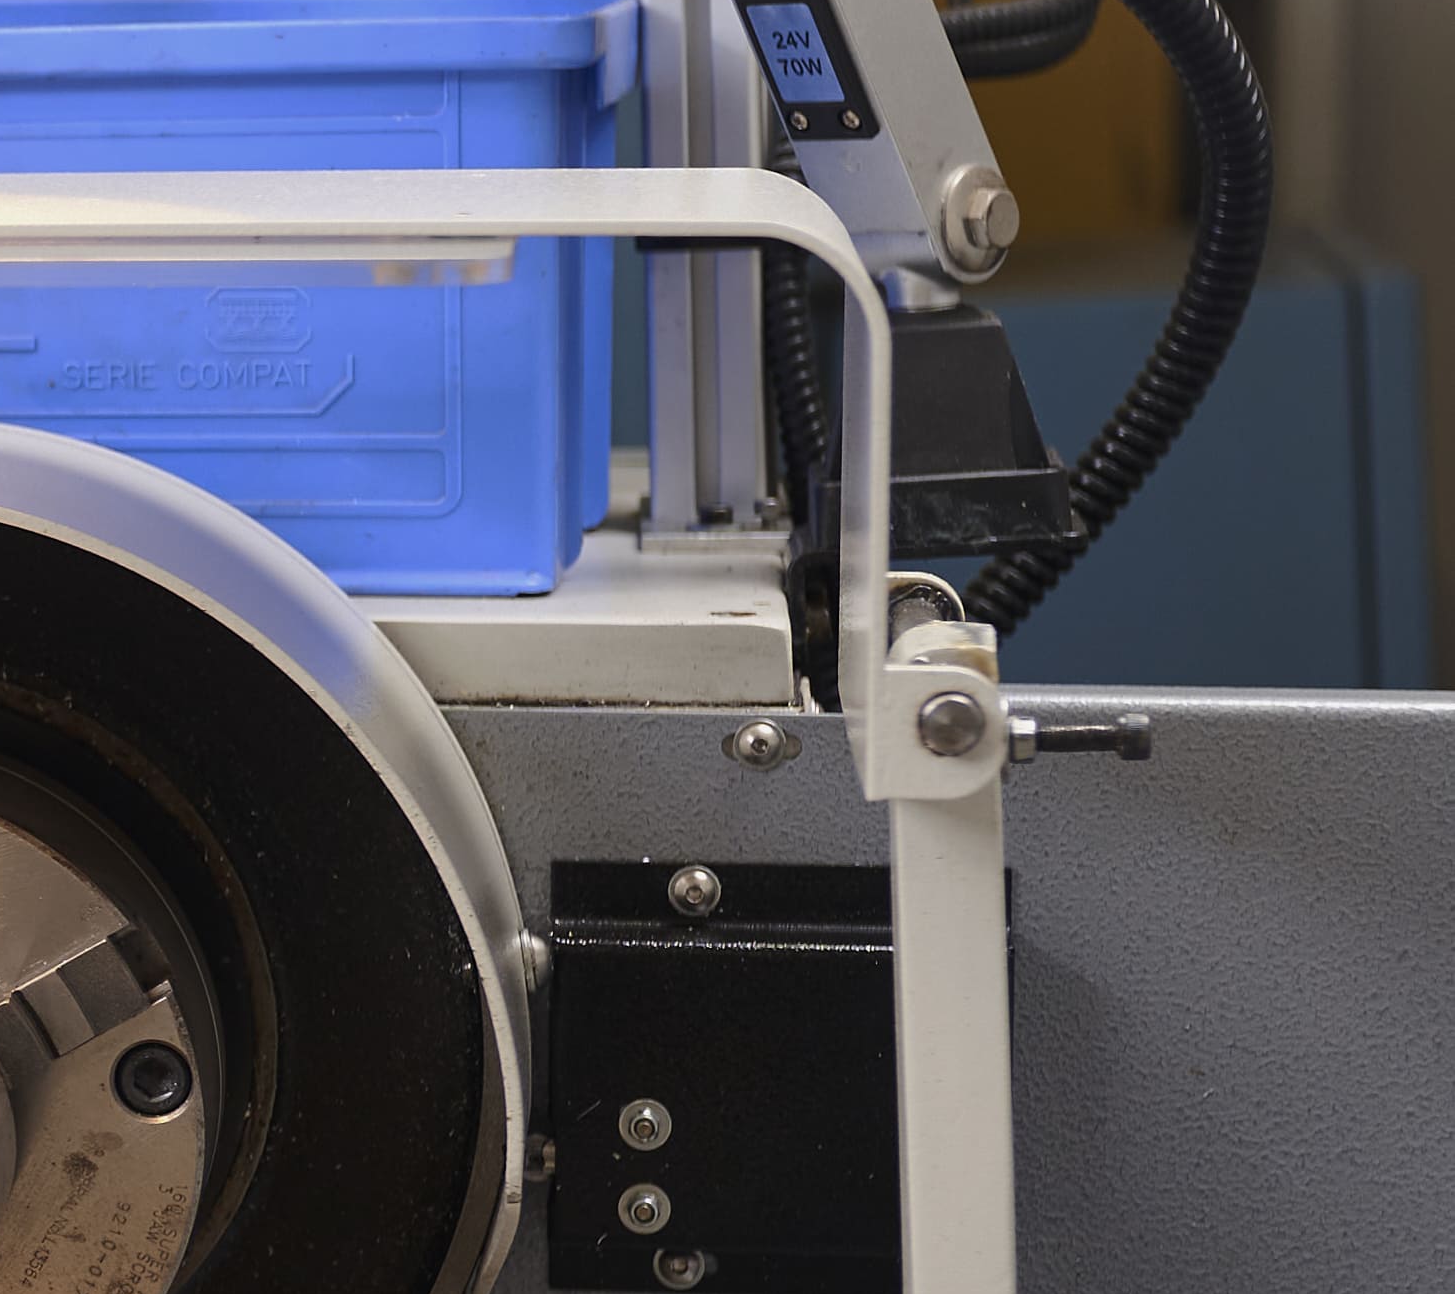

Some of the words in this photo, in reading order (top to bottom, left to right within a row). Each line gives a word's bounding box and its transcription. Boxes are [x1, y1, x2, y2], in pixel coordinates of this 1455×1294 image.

[772, 31, 810, 50] 24V
[777, 58, 823, 77] 70W
[63, 361, 156, 390] SERIE
[177, 361, 312, 390] COMPAT
